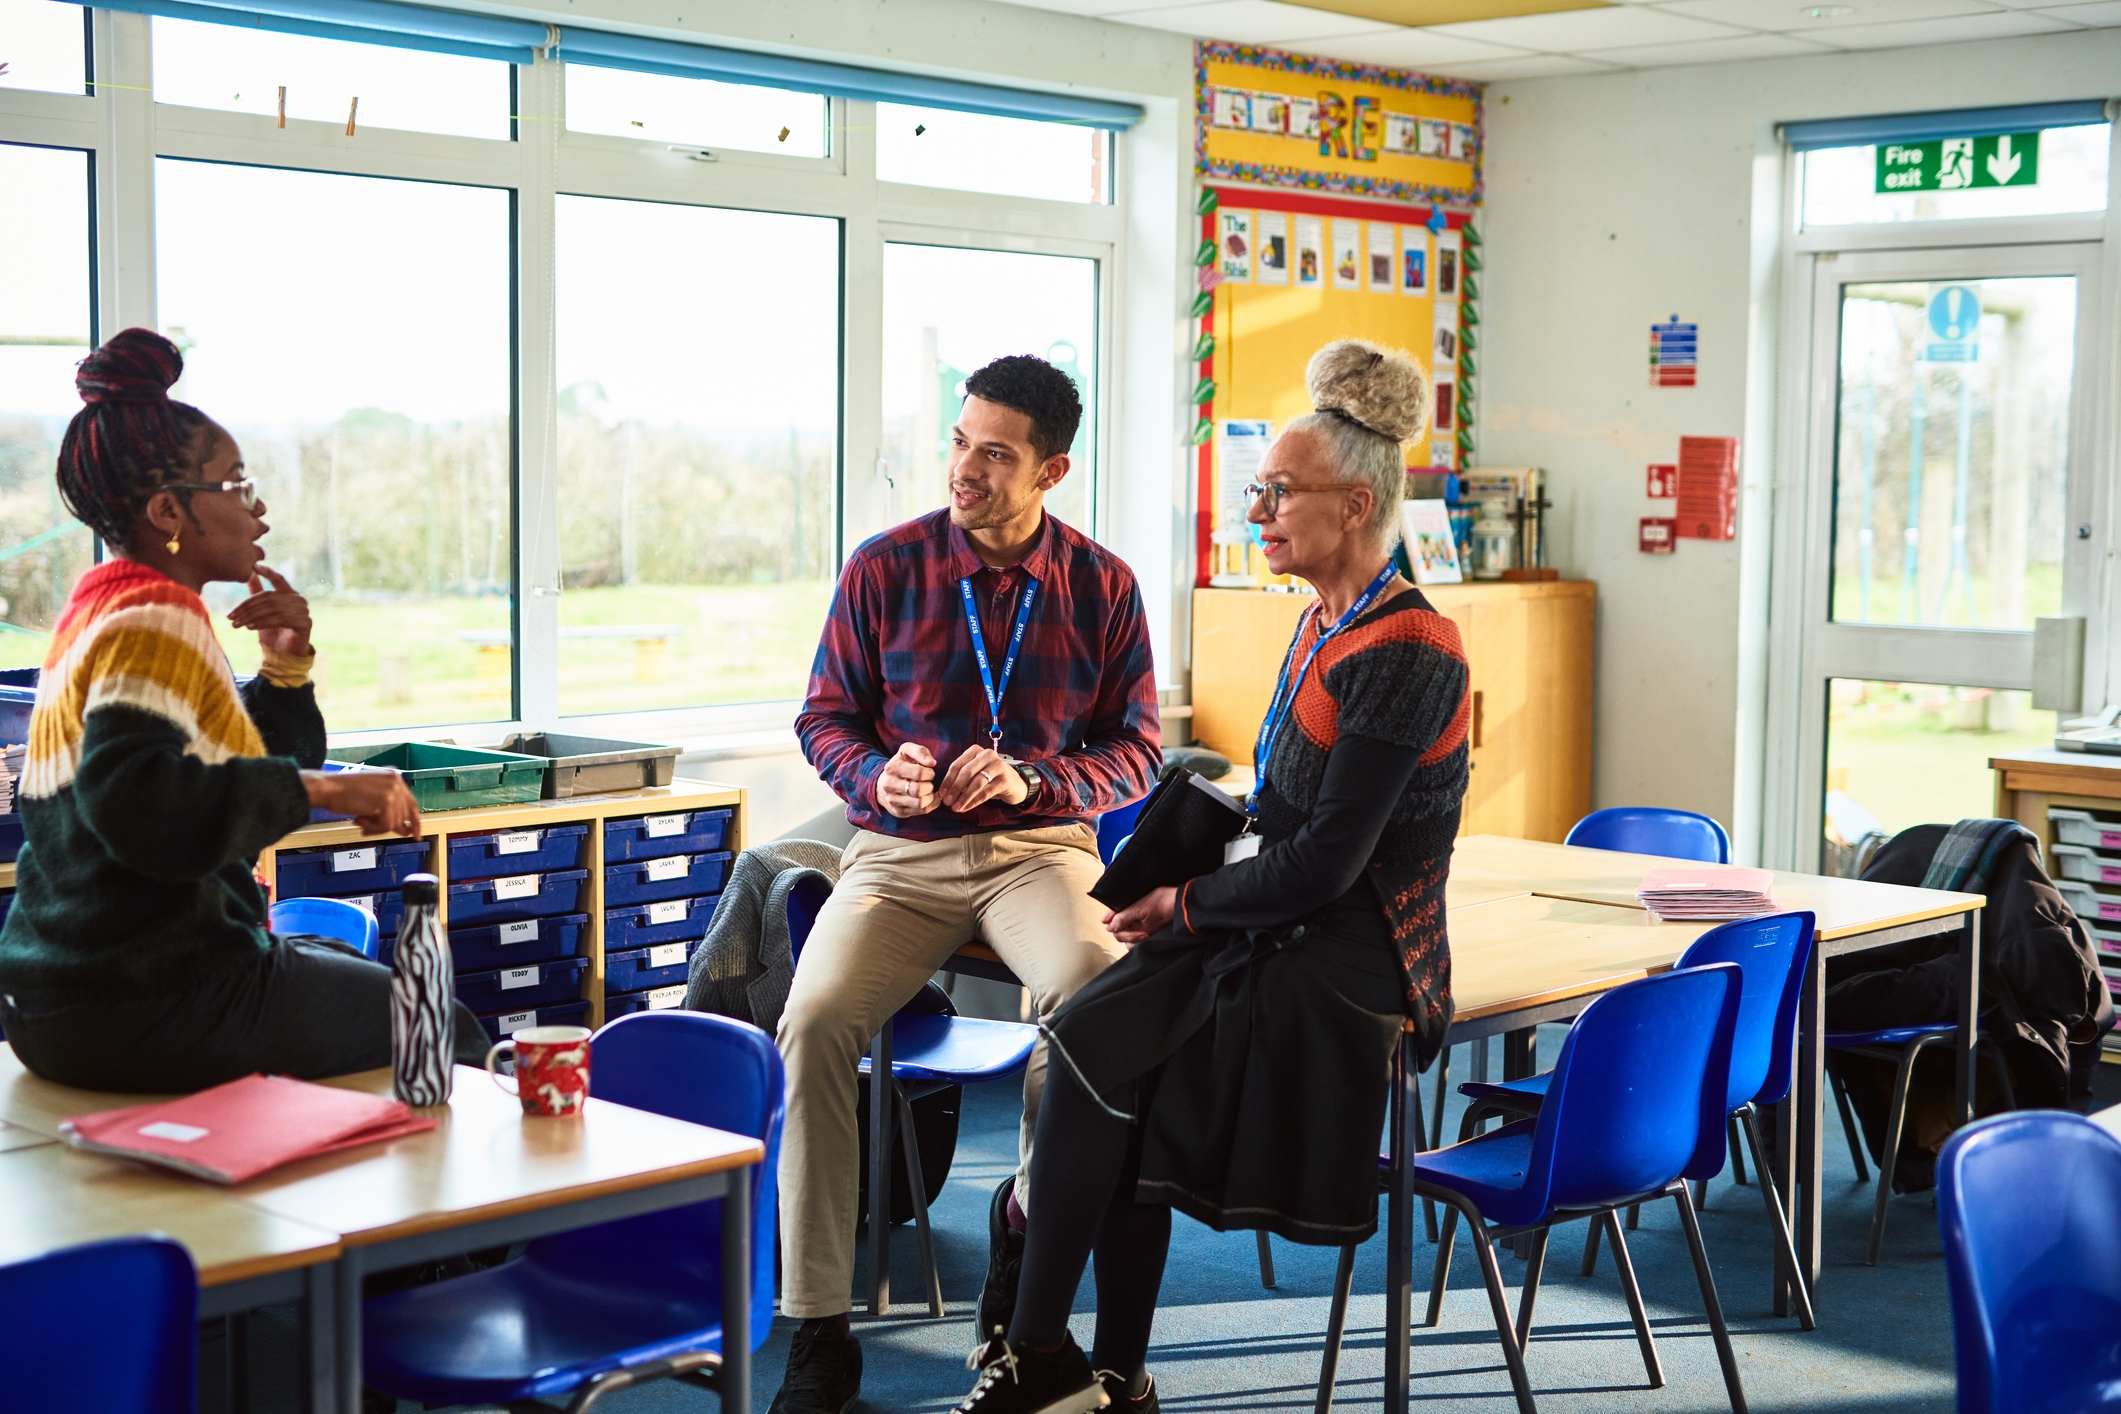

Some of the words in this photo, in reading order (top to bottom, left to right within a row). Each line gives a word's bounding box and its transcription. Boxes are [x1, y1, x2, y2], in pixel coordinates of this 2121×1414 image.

[1317, 90, 1381, 162] RE
[1885, 146, 1923, 165] Fire
[1885, 169, 1923, 188] exit
[1223, 214, 1247, 232] The
[1223, 261, 1247, 277] Bible
[962, 580, 972, 599] STAFF
[1024, 588, 1034, 609] STAFF
[1352, 592, 1370, 612] STAFF
[969, 614, 979, 634] STAFF
[1015, 622, 1025, 642] STAFF
[1324, 622, 1342, 639] STAFF
[976, 649, 987, 669] STAFF
[1004, 656, 1014, 677] STAFF
[985, 684, 994, 703] STAFF
[1261, 724, 1270, 745] STAFF
[658, 818, 675, 826] DYLAN
[508, 835, 529, 844] TOMMY
[348, 851, 361, 859] ZAC
[659, 860, 675, 868] LAURA
[505, 879, 526, 887] JESSICA
[660, 904, 676, 912] LUCAS
[510, 923, 528, 932] OLIVIA
[511, 969, 529, 978] TEDDY
[508, 1013, 527, 1023] RICKEY
